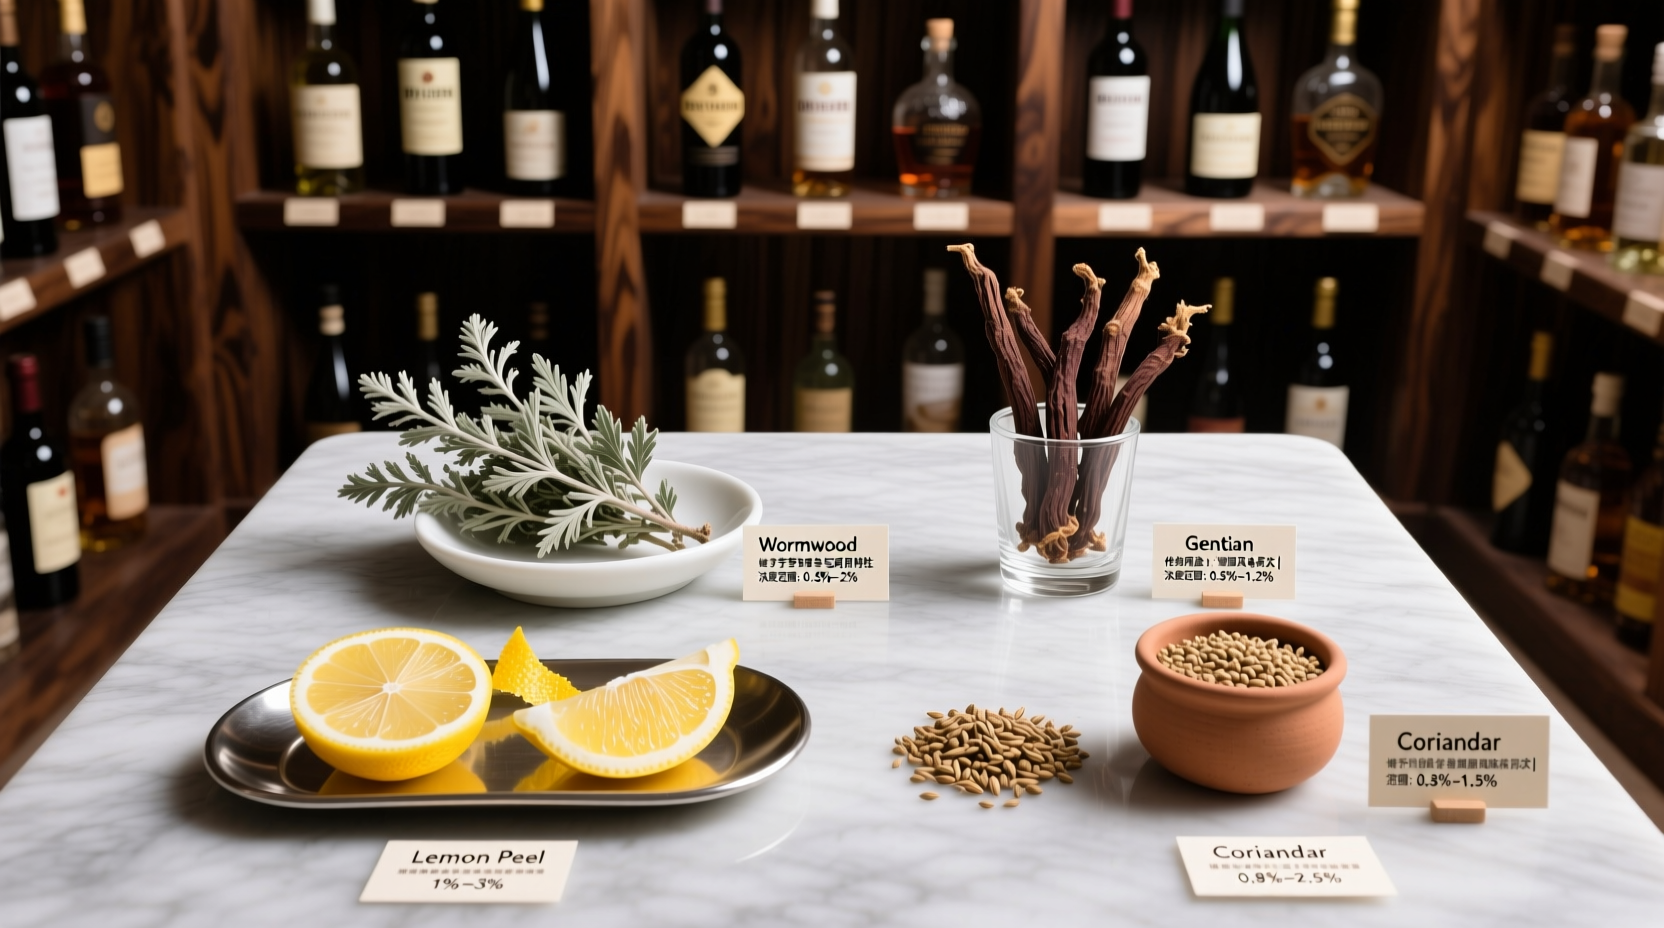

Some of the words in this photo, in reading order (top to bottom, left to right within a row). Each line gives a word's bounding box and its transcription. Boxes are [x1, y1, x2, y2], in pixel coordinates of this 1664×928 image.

[758, 535, 857, 552] Wormwood
[1185, 535, 1254, 552] Gentian
[1397, 731, 1502, 751] Coriandar
[411, 850, 490, 864] Lemon
[497, 850, 546, 864] Peel
[1213, 845, 1327, 859] Coriandar
